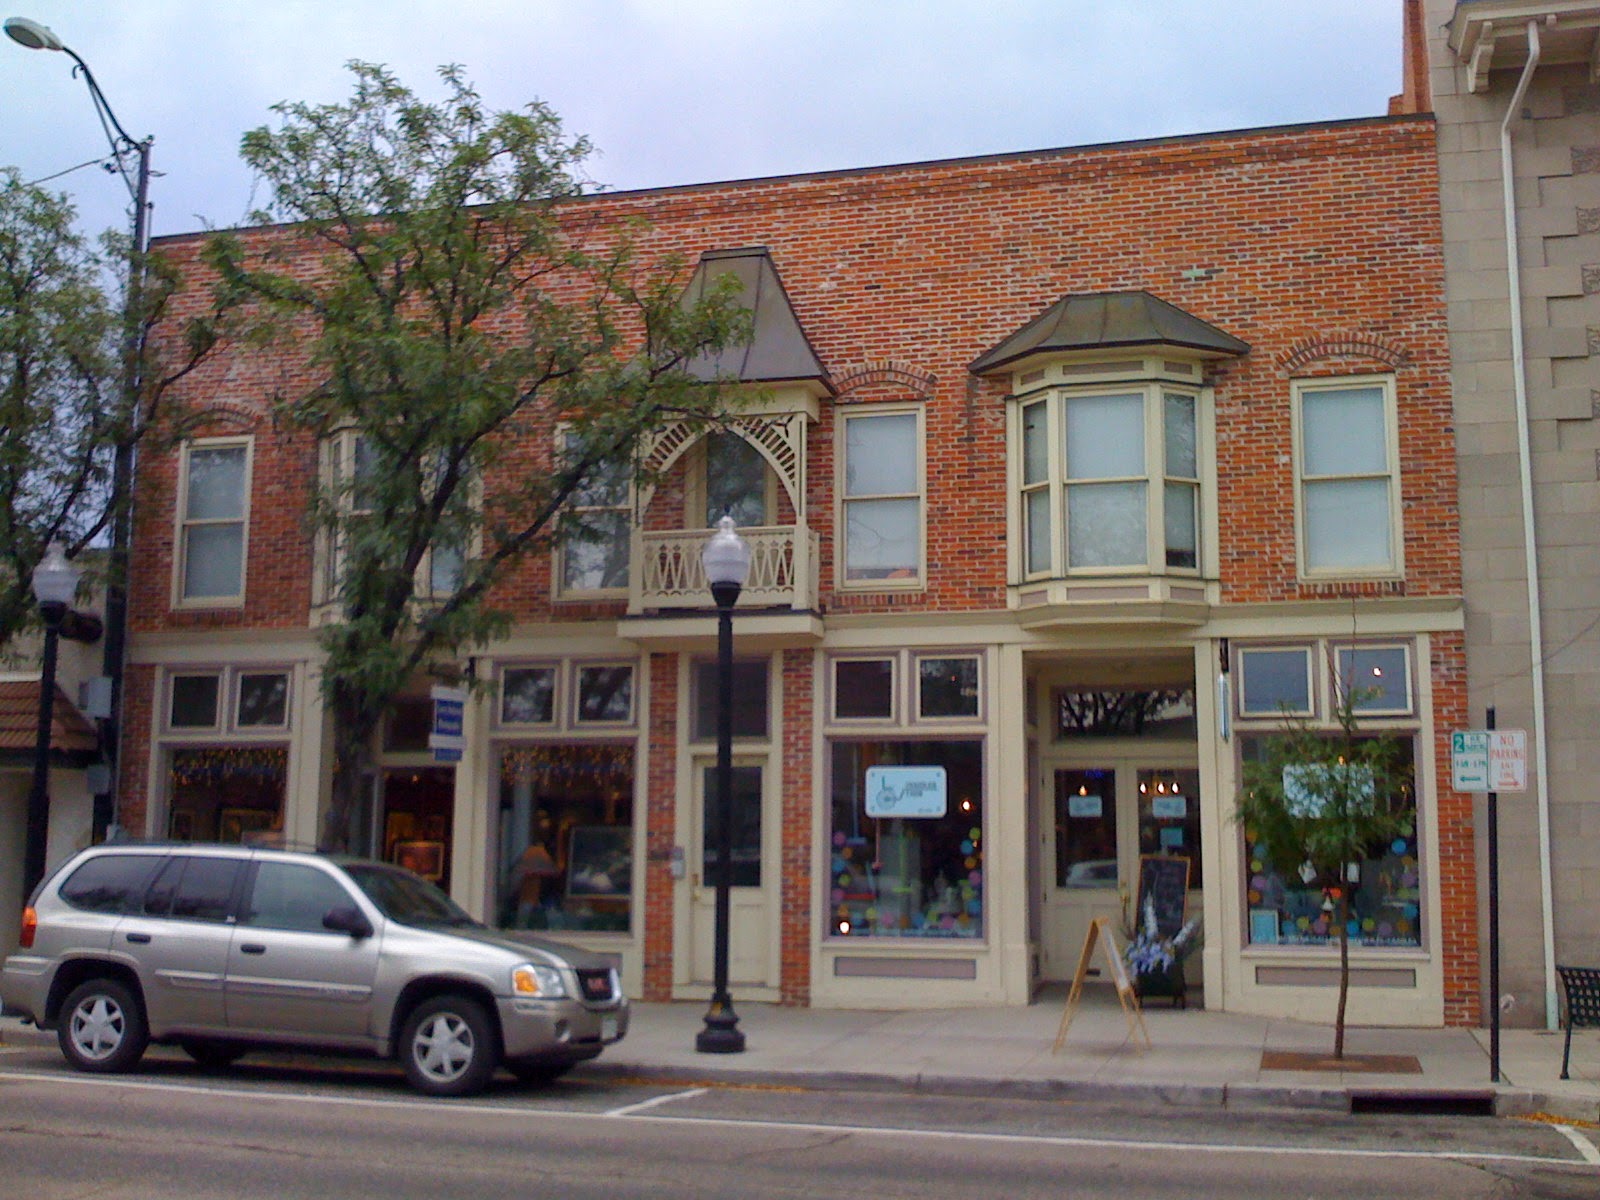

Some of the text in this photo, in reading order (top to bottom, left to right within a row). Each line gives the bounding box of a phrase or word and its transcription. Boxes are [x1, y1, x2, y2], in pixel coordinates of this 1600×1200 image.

[1454, 735, 1463, 752] 2
[1500, 735, 1514, 746] NO
[1490, 748, 1524, 760] PARKING
